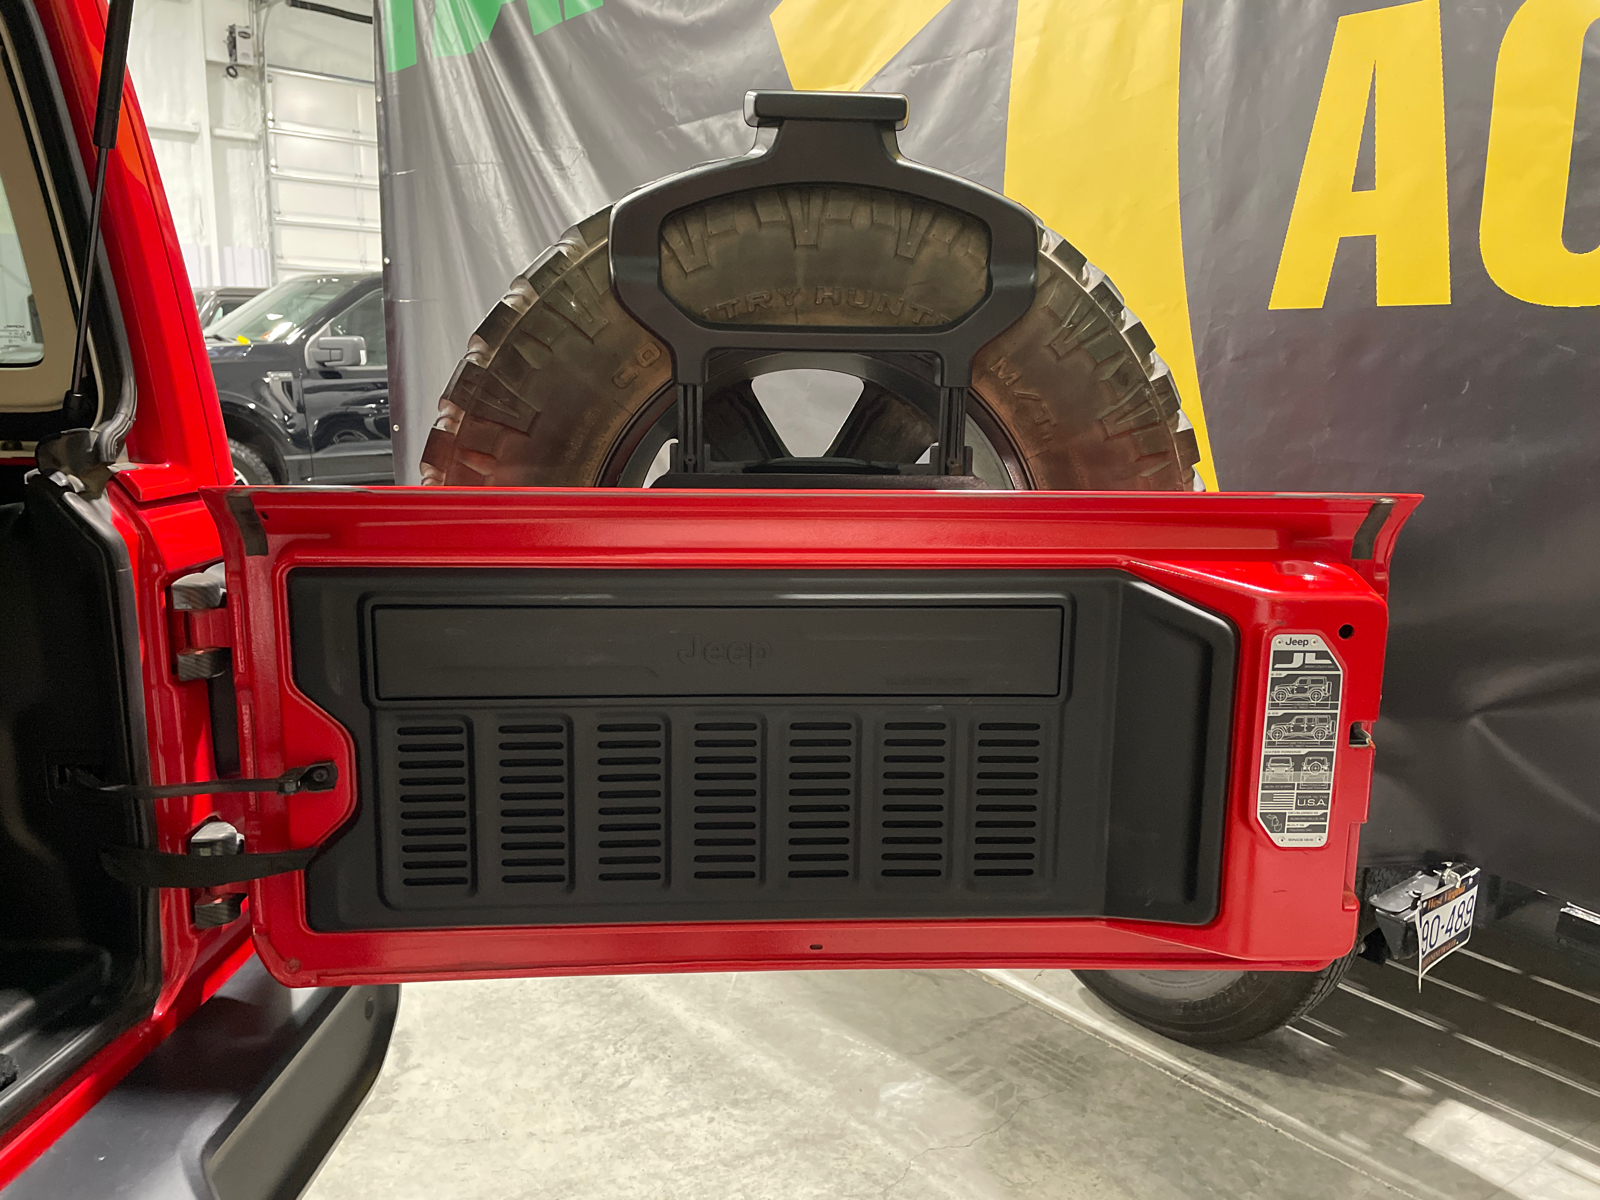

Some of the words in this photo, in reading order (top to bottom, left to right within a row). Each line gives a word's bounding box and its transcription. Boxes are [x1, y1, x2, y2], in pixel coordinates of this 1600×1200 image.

[677, 634, 773, 669] Jeep
[1285, 637, 1309, 647] Jeep
[1274, 652, 1333, 669] JL
[1421, 894, 1475, 956] 90-489
